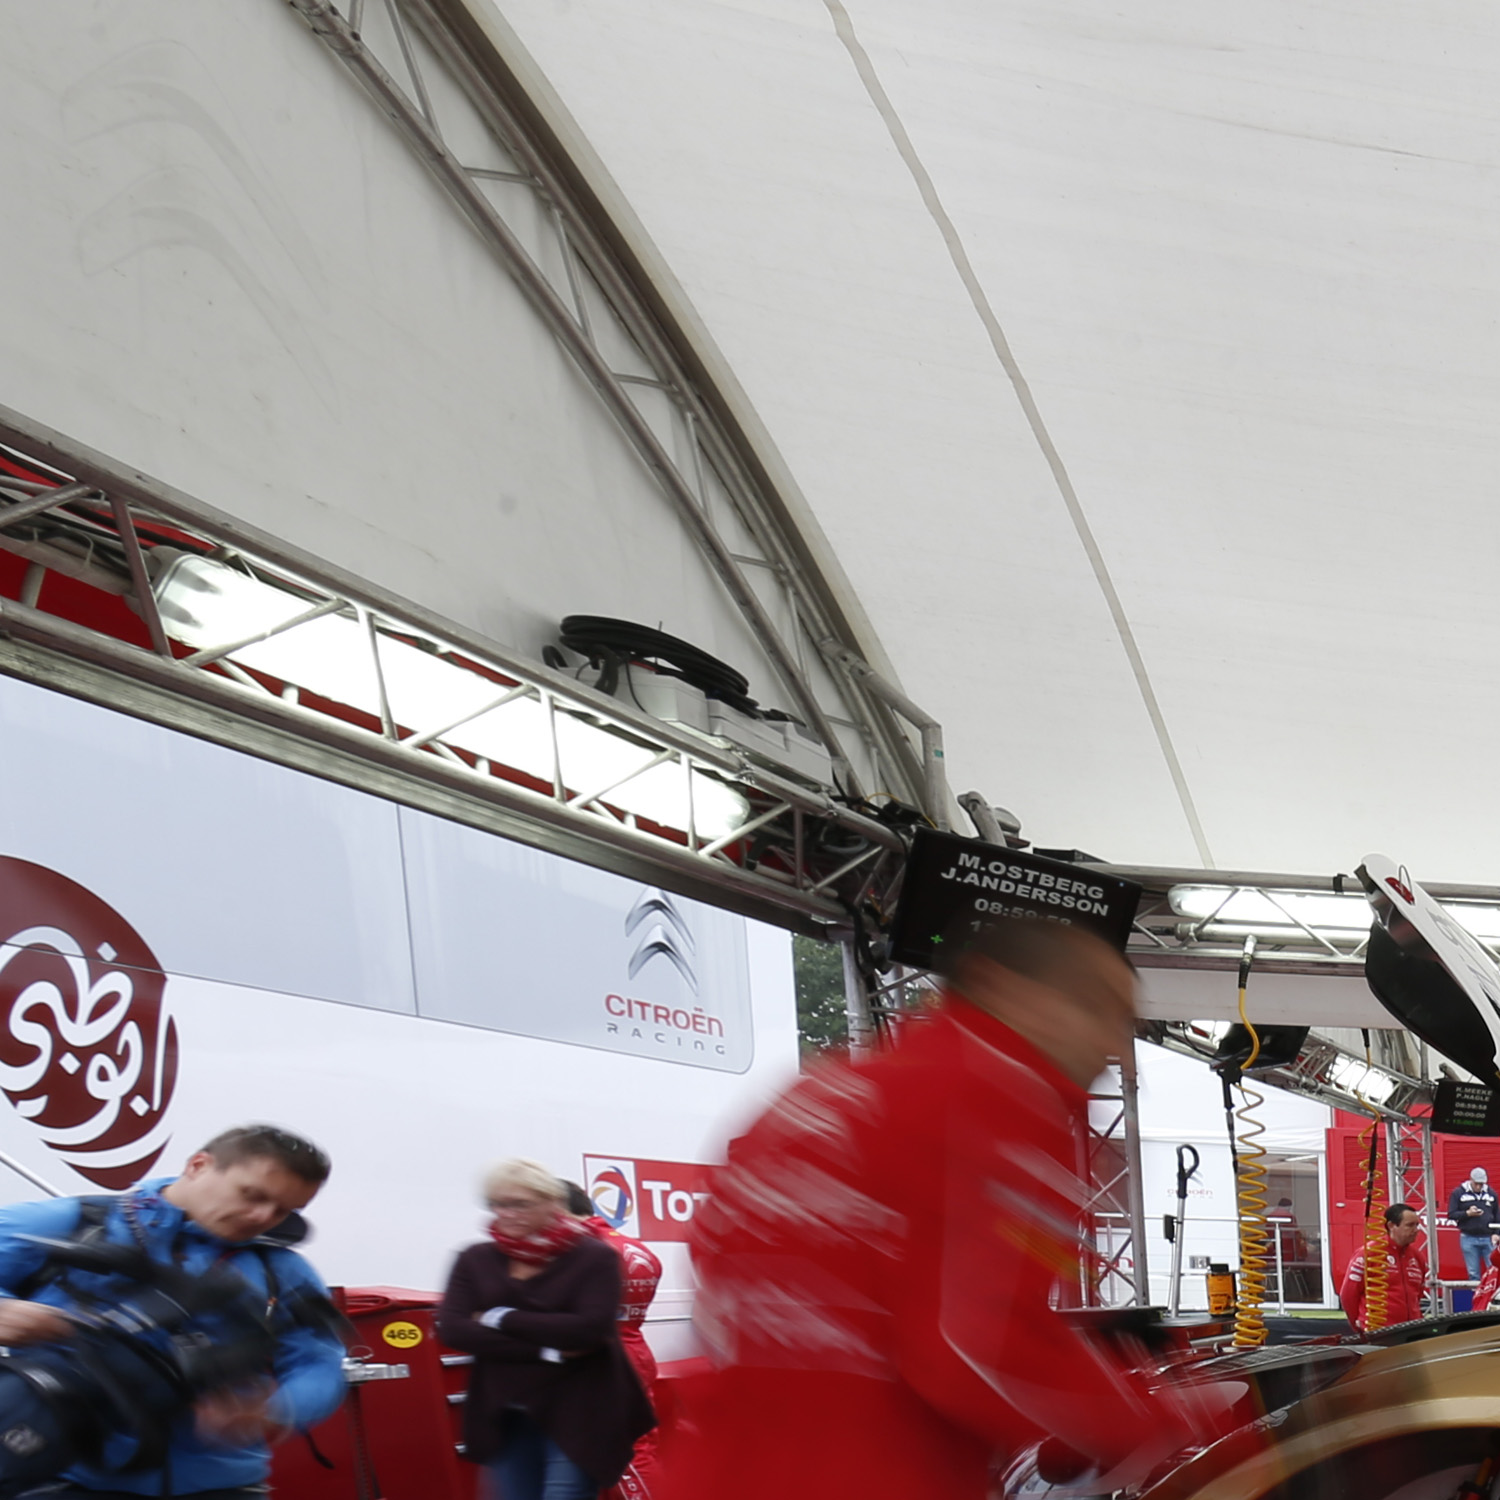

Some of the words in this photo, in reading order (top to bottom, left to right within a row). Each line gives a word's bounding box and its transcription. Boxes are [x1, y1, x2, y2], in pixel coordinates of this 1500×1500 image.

[941, 867, 1109, 916] J.ANDERSSON
[958, 853, 1104, 899] M.OSTBERG
[606, 1022, 725, 1055] RACING
[386, 1328, 420, 1342] 465
